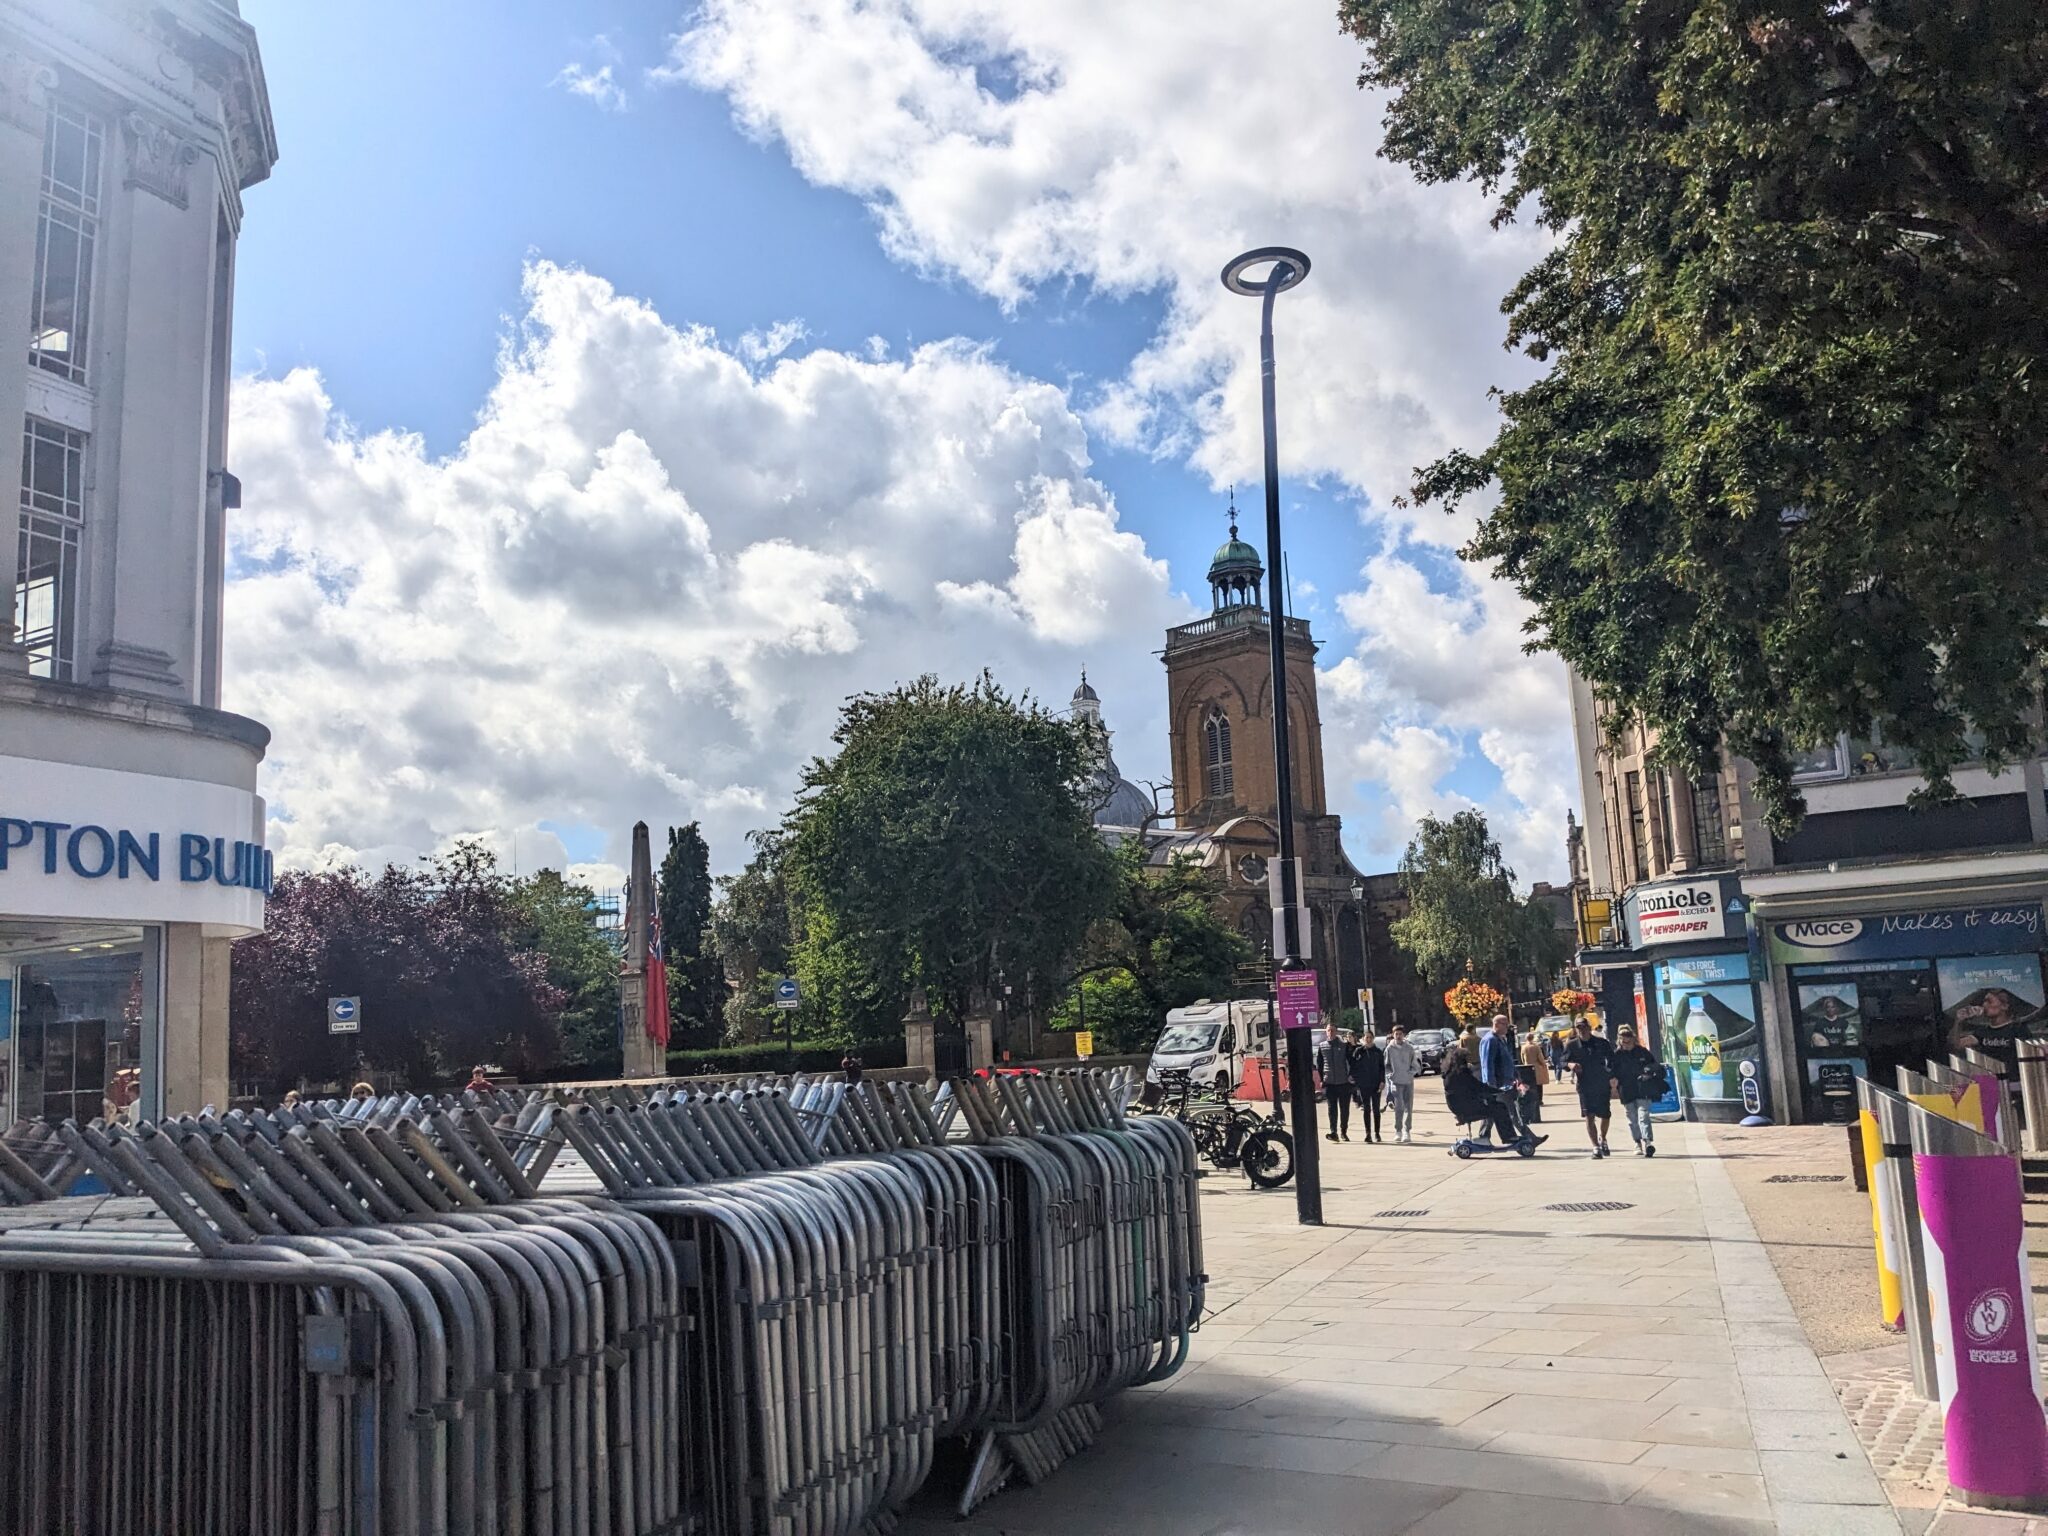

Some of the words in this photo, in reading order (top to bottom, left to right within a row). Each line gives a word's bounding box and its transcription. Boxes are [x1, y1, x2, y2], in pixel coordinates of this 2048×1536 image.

[0, 817, 160, 881] PTON
[1653, 920, 1709, 935] NEWSPAPER
[1795, 920, 1854, 938] Mace
[1882, 914, 1953, 935] Makes
[1965, 909, 1983, 927] it
[1696, 960, 1716, 970] FORCE
[1704, 968, 1726, 979] TWIST
[1690, 1041, 1716, 1054] Volvic
